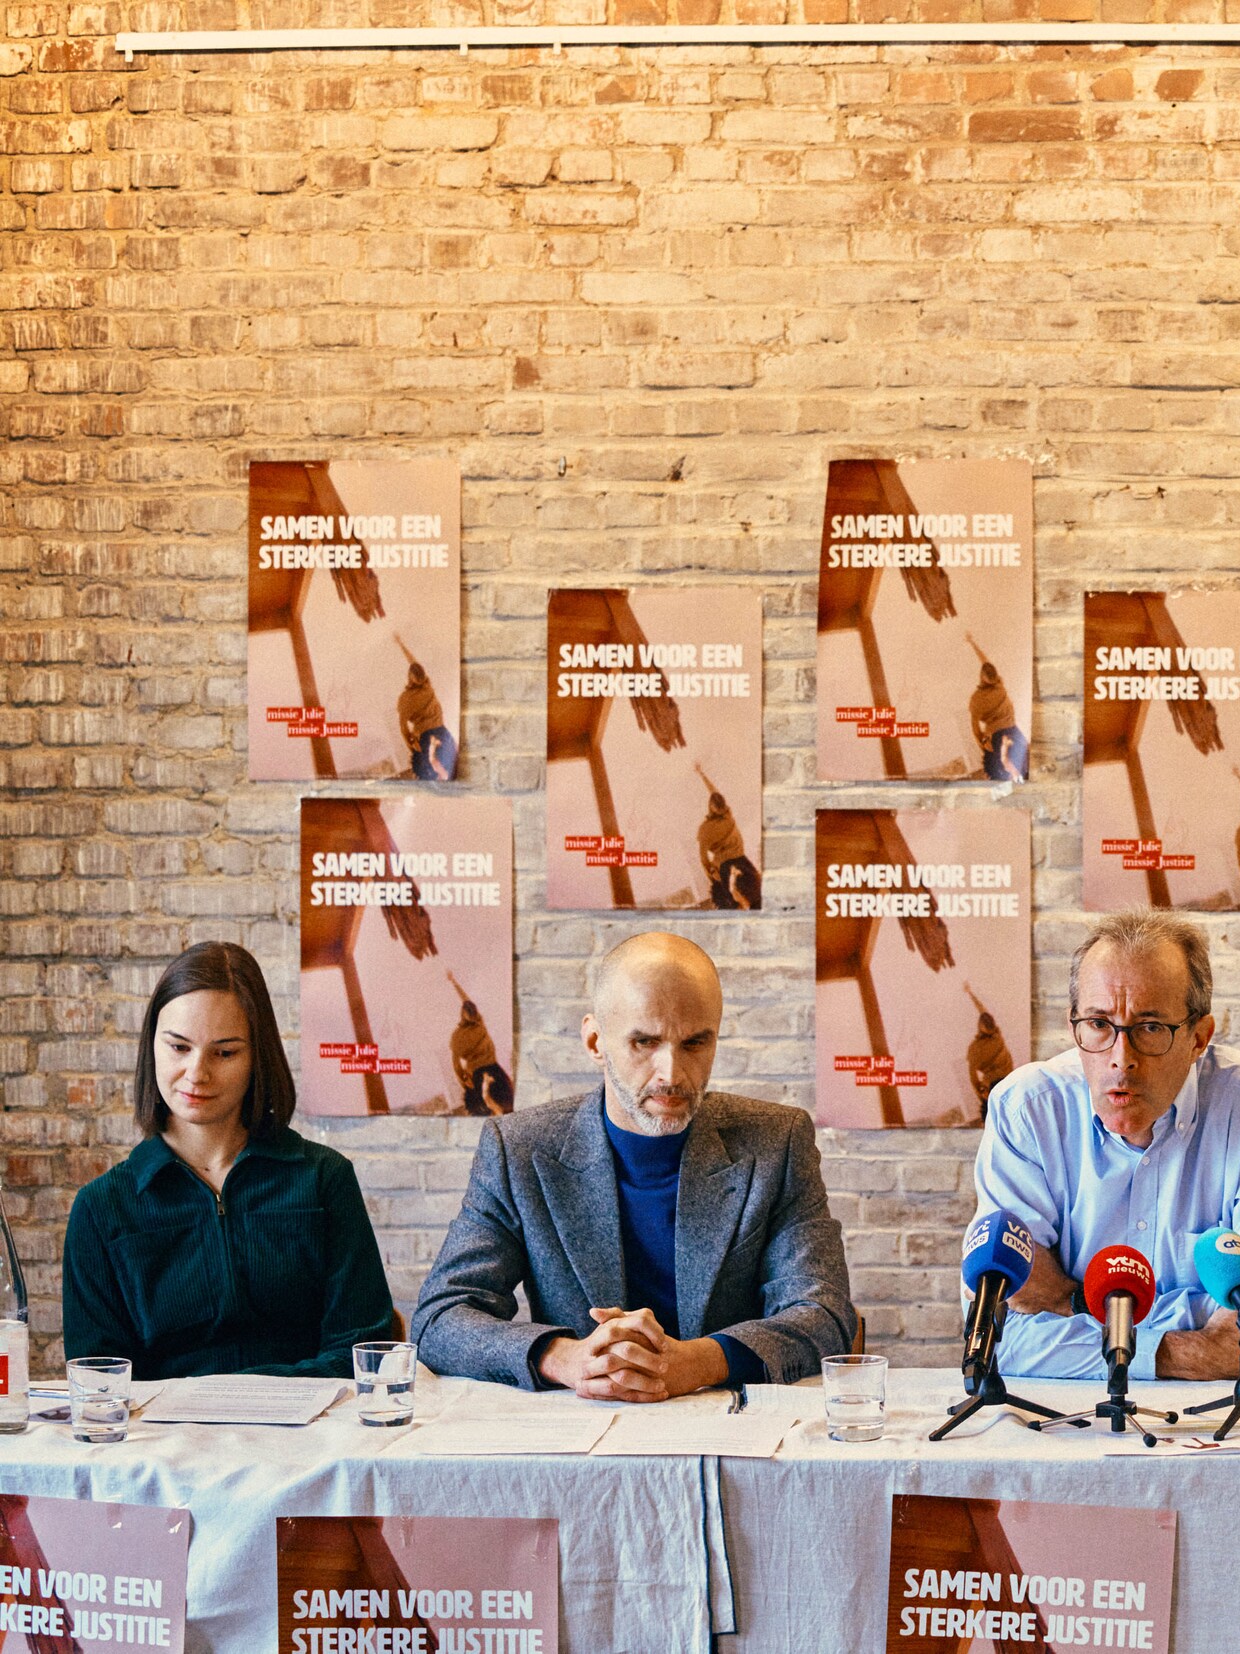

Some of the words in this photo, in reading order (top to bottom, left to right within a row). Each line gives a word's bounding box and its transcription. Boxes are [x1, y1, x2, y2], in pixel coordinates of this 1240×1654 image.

[260, 515, 334, 540] SAMEN
[339, 515, 397, 540] VOOR
[401, 514, 441, 539] EEN
[830, 514, 904, 539] SAMEN
[908, 514, 968, 538] VOOR
[972, 513, 1014, 538] EEN
[259, 544, 362, 569] STERKERE
[366, 543, 449, 568] JUSTITIE
[828, 543, 932, 568] STERKERE
[937, 543, 1022, 568] JUSTITIE
[558, 643, 634, 668] SAMEN
[639, 644, 697, 668] VOOR
[701, 644, 743, 668] EEN
[1095, 646, 1171, 671] SAMEN
[1176, 647, 1235, 671] VOOR
[557, 673, 662, 698] STERKERE
[666, 673, 750, 698] JUSTITIE
[1094, 676, 1200, 700] STERKERE
[267, 708, 299, 719] missie
[299, 708, 325, 721] Julie
[836, 708, 869, 719] missie
[869, 708, 896, 722] Julie
[288, 723, 319, 735] missie
[320, 723, 357, 737] Justitie
[857, 724, 890, 735] missie
[890, 723, 928, 737] Justitie
[565, 837, 598, 848] missie
[598, 837, 624, 851] Julie
[1102, 840, 1135, 851] missie
[1135, 840, 1161, 854] Julie
[312, 852, 385, 877] SAMEN
[390, 852, 448, 877] VOOR
[452, 853, 493, 877] EEN
[586, 853, 619, 864] missie
[619, 852, 657, 866] Justitie
[1123, 856, 1156, 867] missie
[1156, 855, 1194, 870] Justitie
[827, 863, 902, 888] SAMEN
[907, 863, 966, 888] VOOR
[970, 863, 1011, 888] EEN
[310, 881, 413, 907] STERKERE
[417, 882, 500, 907] JUSTITIE
[825, 893, 930, 918] STERKERE
[935, 893, 1019, 917] JUSTITIE
[320, 1045, 351, 1056] missie
[352, 1045, 377, 1058] Julie
[835, 1057, 867, 1068] missie
[868, 1057, 894, 1071] Julie
[341, 1060, 372, 1071] missie
[373, 1059, 410, 1073] Justitie
[856, 1072, 888, 1083] missie
[888, 1072, 926, 1086] Justitie
[1007, 1220, 1033, 1248] vrt
[1006, 1236, 1030, 1258] nws
[1106, 1256, 1150, 1279] vtm
[1108, 1264, 1150, 1285] nieuws
[0, 1565, 31, 1597] EN
[38, 1568, 107, 1604] VOOR
[114, 1575, 162, 1609] EEN
[903, 1568, 1002, 1602] SAMEN
[1009, 1573, 1086, 1608] VOOR
[1093, 1578, 1146, 1612] EEN
[292, 1589, 390, 1619] SAMEN
[397, 1589, 474, 1620] VOOR
[481, 1589, 533, 1620] EEN
[0, 1602, 64, 1637] KERE
[70, 1609, 171, 1647] JUSTITIE
[899, 1606, 1037, 1642] STERKERE
[1043, 1614, 1154, 1650] JUSTITIE
[291, 1626, 427, 1654] STERKERE
[435, 1627, 544, 1654] JUSTITIE
